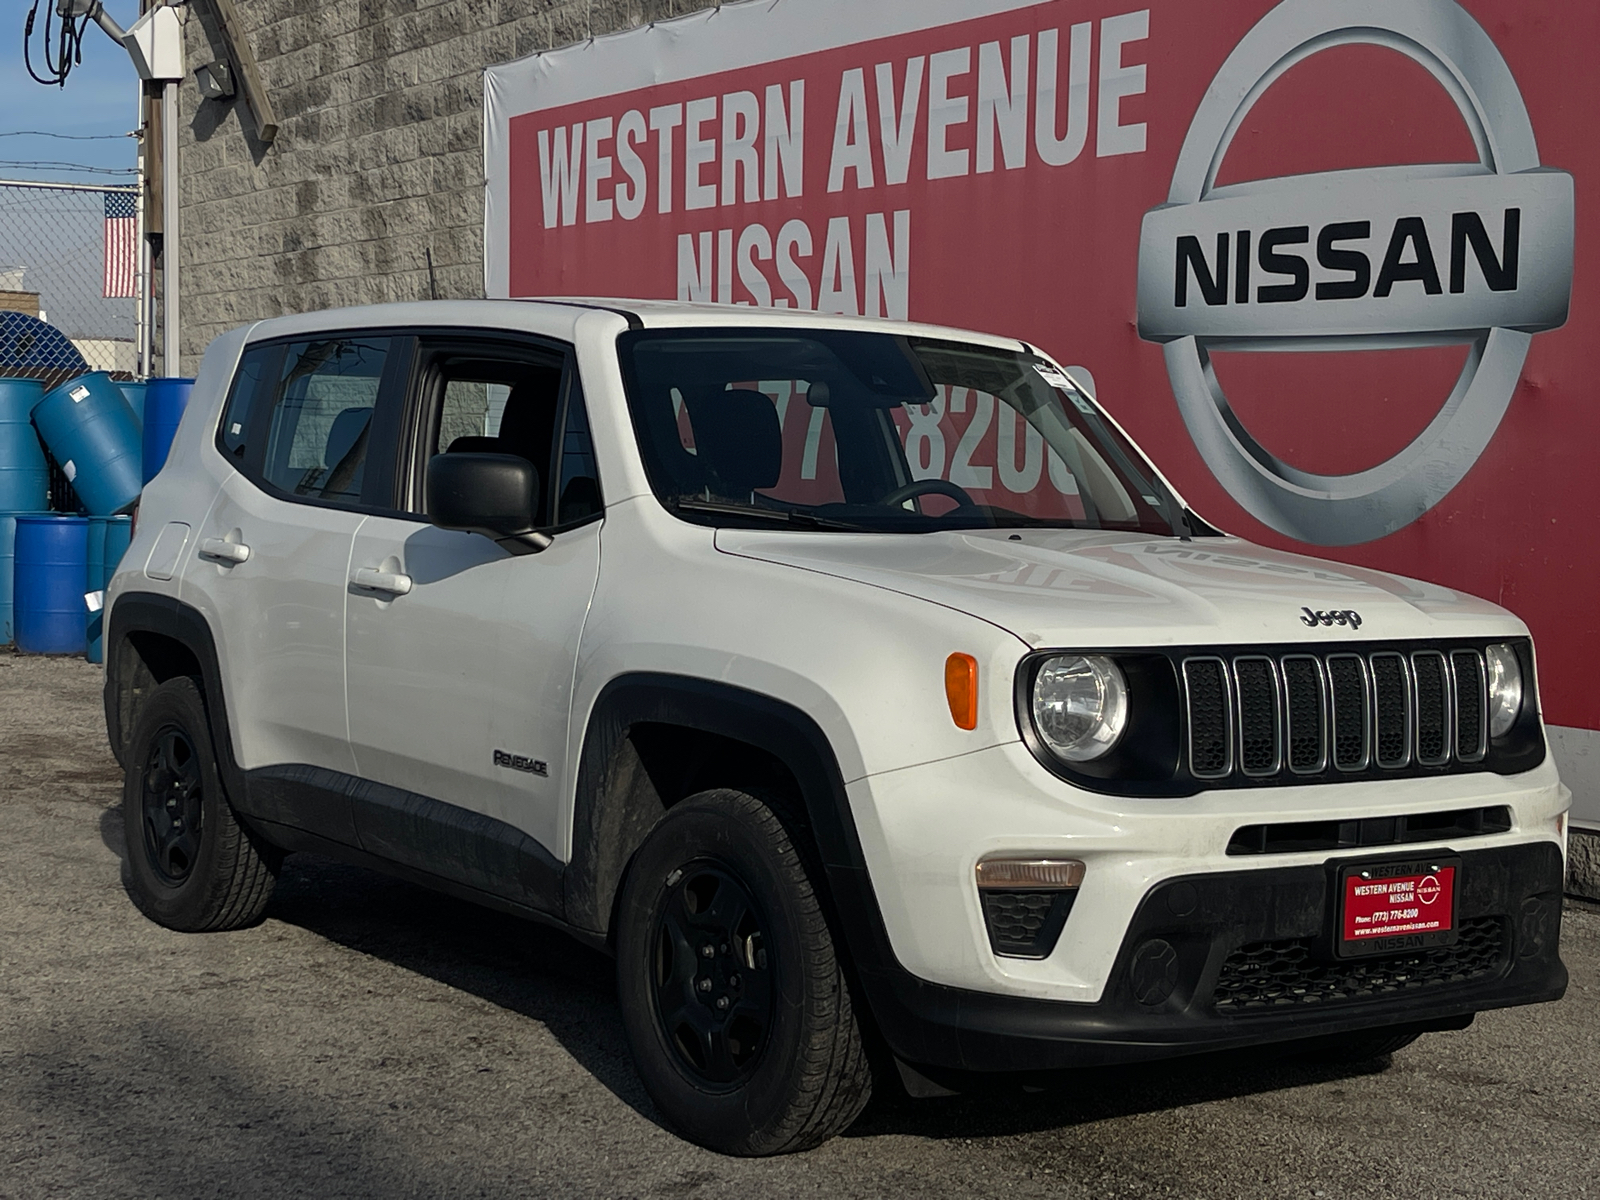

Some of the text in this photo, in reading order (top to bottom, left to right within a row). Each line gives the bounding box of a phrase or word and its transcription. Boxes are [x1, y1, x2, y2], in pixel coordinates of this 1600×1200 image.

[537, 9, 1150, 229] WESTERN AVENUE
[676, 209, 911, 321] NISSAN
[1174, 208, 1521, 308] NISSAN
[1299, 606, 1363, 630] Jeep
[493, 749, 549, 777] RENEGADE
[1371, 864, 1413, 878] WESTERN
[1354, 881, 1415, 897] WESTERN AVENUE
[1416, 886, 1441, 894] NISSAN
[1389, 892, 1415, 904] NISSAN
[1372, 911, 1389, 924] (773)
[1390, 908, 1419, 920] 776-8200
[1373, 935, 1424, 951] NISSAN
